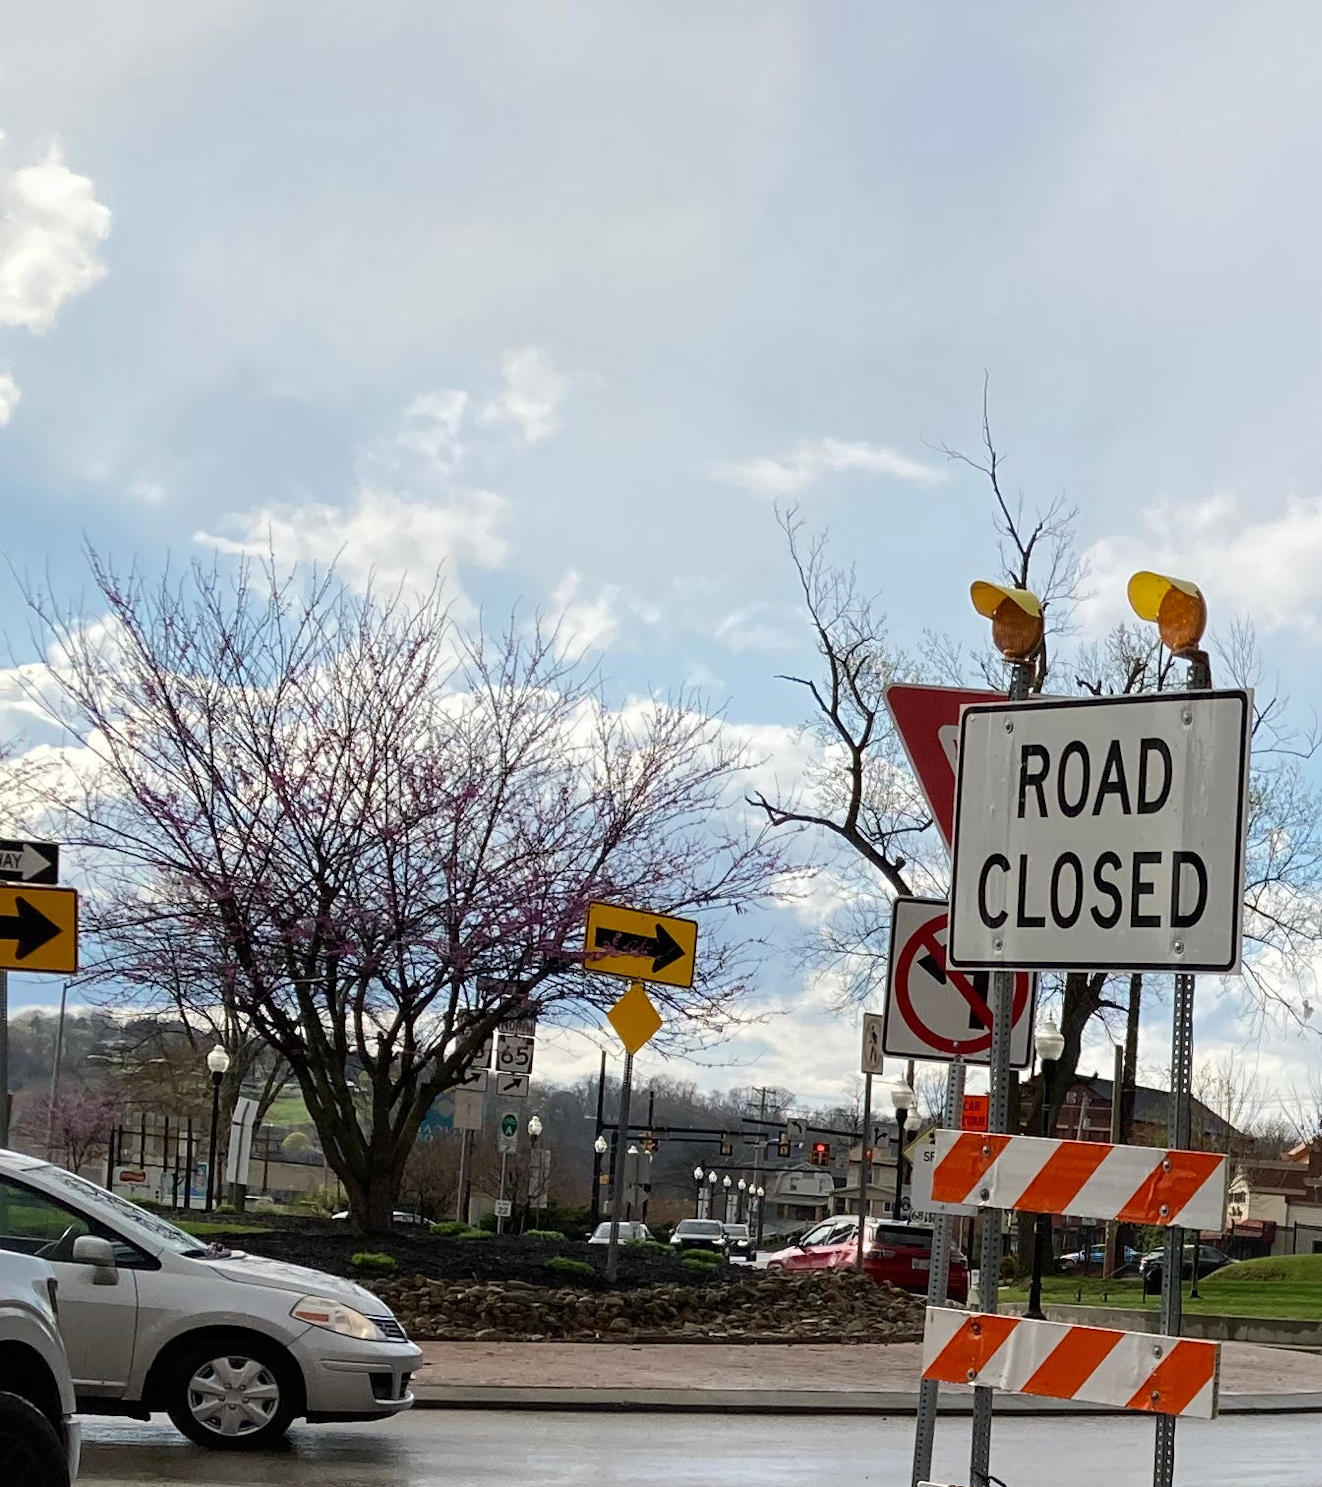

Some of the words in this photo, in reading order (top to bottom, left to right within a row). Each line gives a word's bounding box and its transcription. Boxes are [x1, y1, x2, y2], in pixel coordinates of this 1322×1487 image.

[1017, 737, 1172, 819] ROAD
[0, 853, 22, 869] AY
[977, 850, 1208, 929] CLOSED
[501, 1045, 529, 1066] 65
